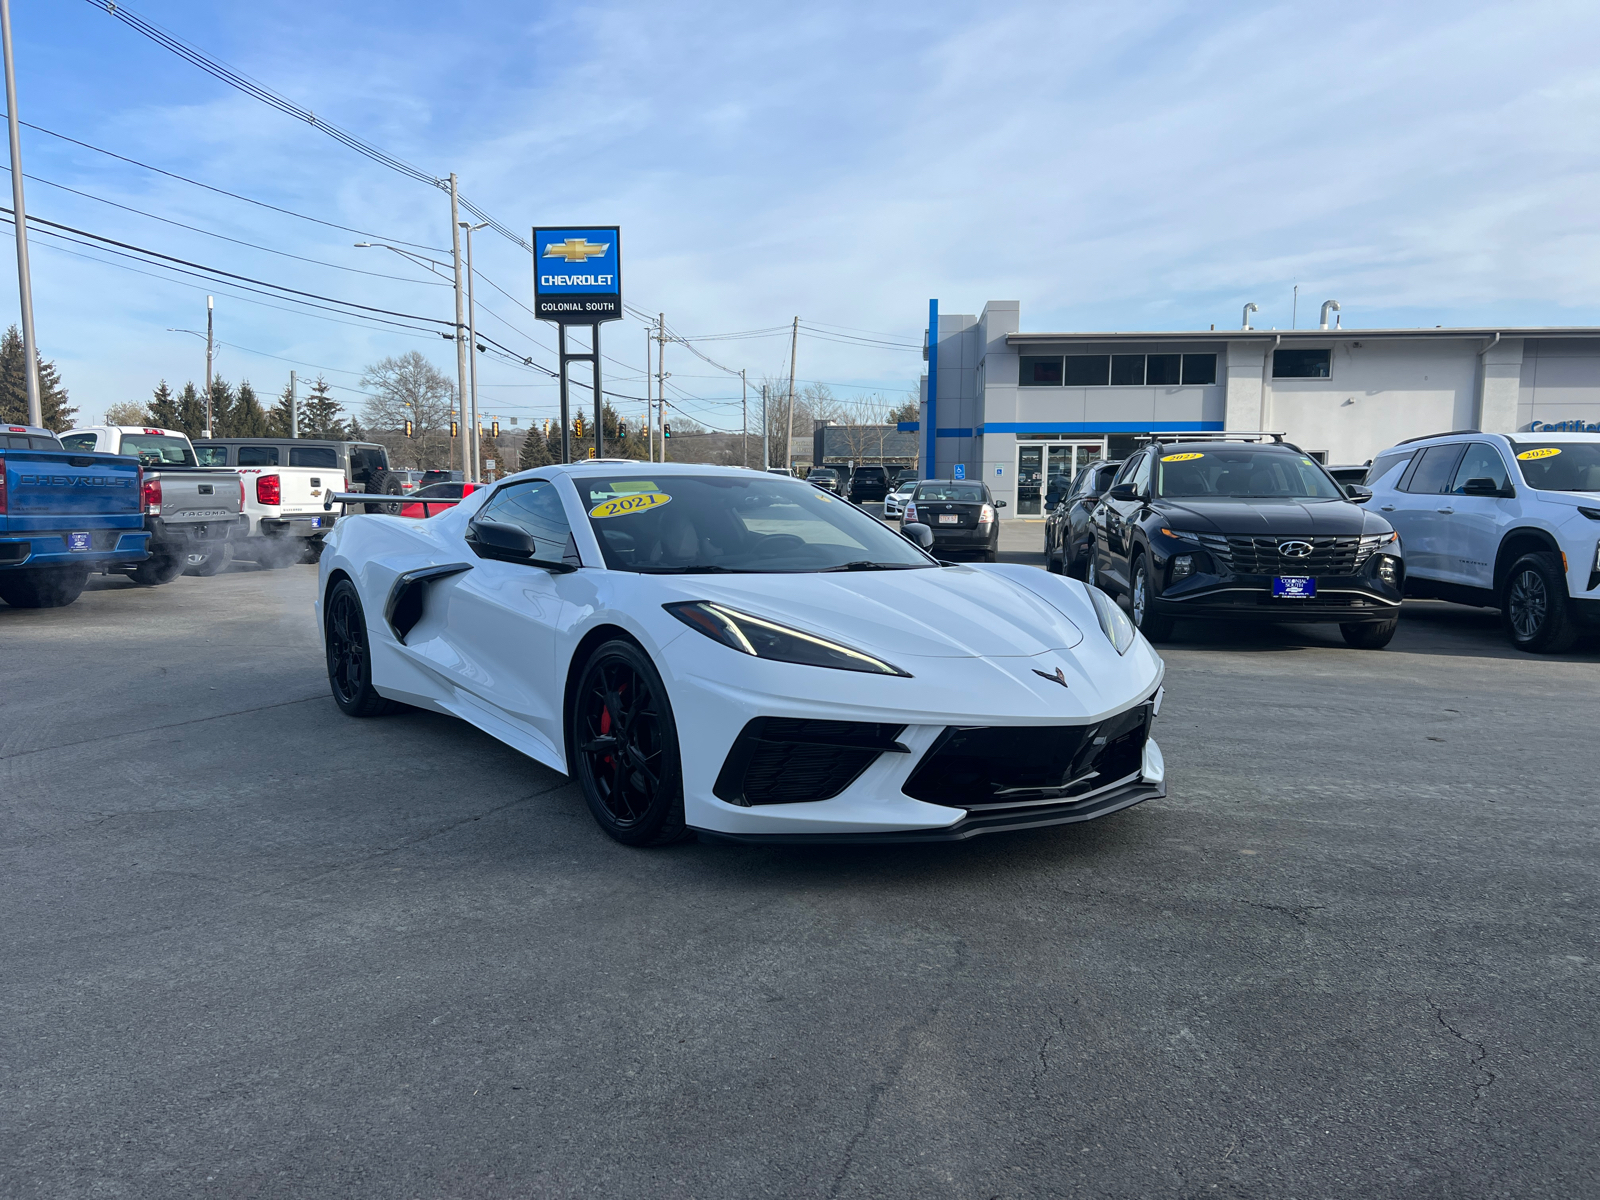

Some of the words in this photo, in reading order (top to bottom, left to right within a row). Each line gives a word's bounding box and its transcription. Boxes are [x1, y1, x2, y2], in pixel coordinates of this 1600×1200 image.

[541, 275, 613, 286] CHEVROLET
[541, 303, 583, 311] COLONIAL
[586, 302, 614, 311] SOUTH
[1531, 420, 1600, 432] Certifie
[1169, 453, 1197, 461] 2022
[1525, 449, 1552, 459] 2025
[20, 474, 137, 487] CHEVROLET
[605, 494, 658, 515] 2021
